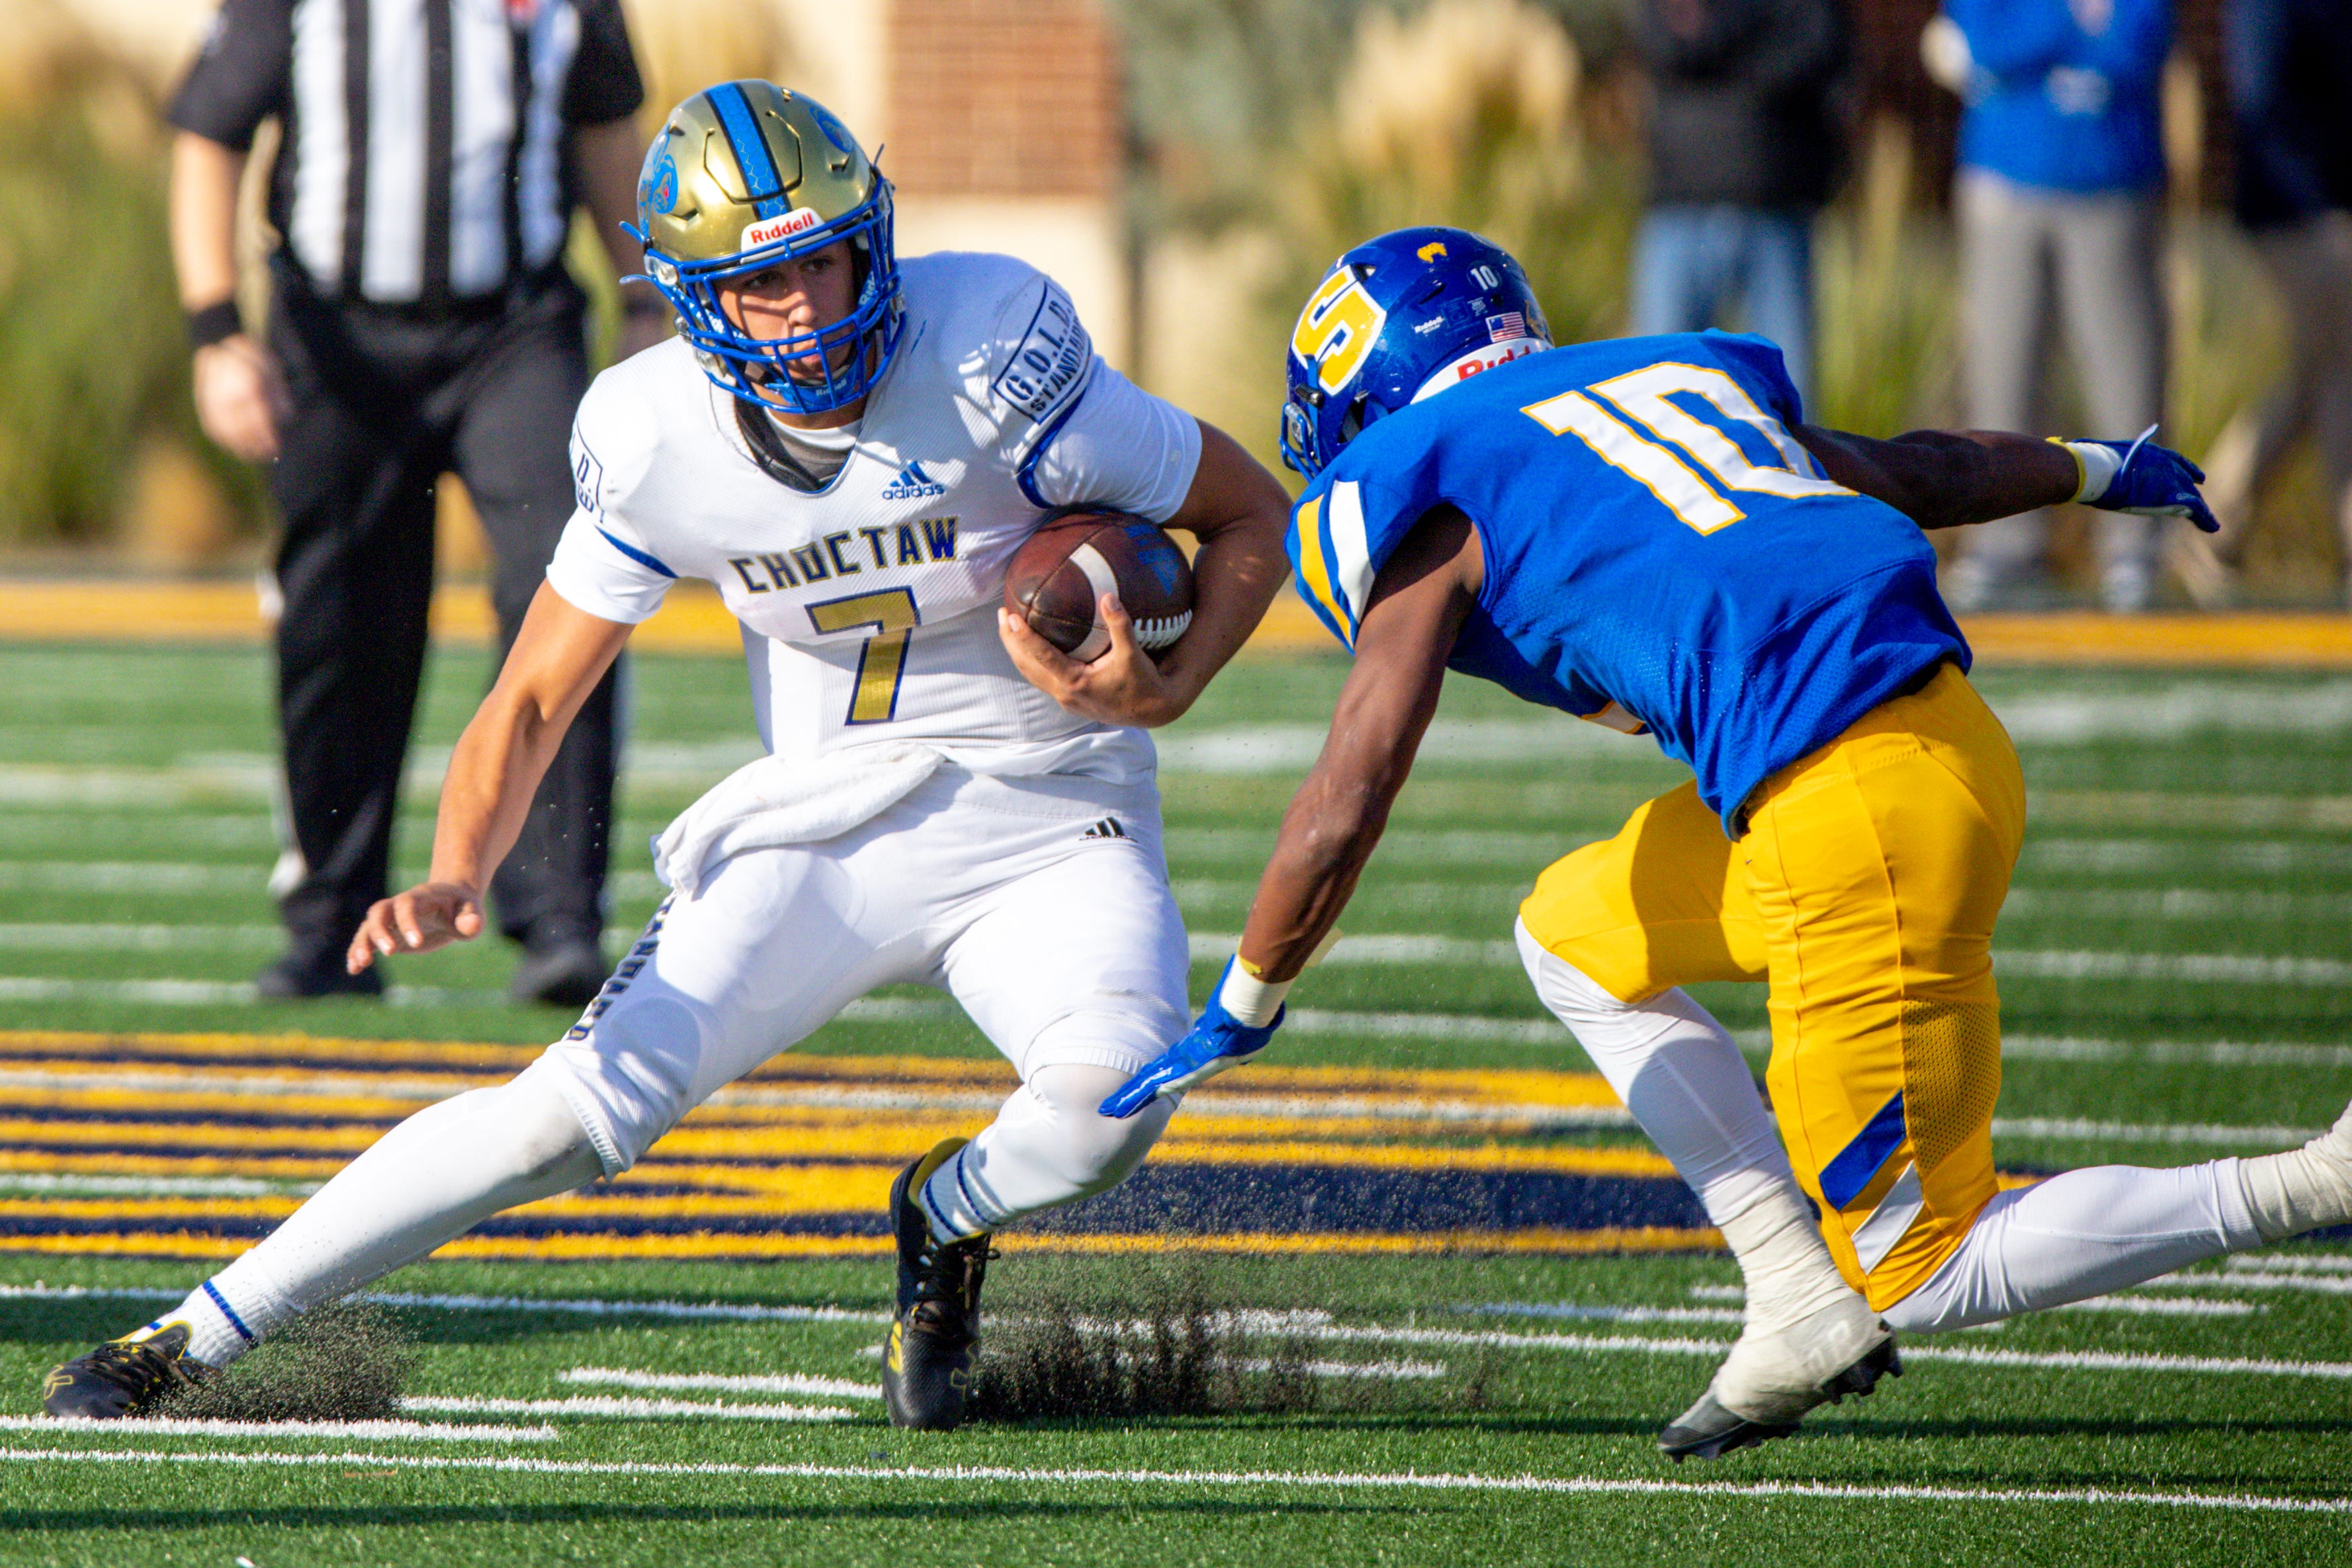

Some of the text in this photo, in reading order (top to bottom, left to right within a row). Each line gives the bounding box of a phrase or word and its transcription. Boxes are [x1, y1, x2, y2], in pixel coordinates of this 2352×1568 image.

[750, 212, 813, 243] Riddell
[1470, 265, 1499, 290] 10
[1291, 264, 1386, 396] S
[1520, 361, 1860, 537] 10
[883, 484, 945, 500] adidas
[728, 515, 958, 594] CHOCTAW
[804, 585, 922, 726] 7
